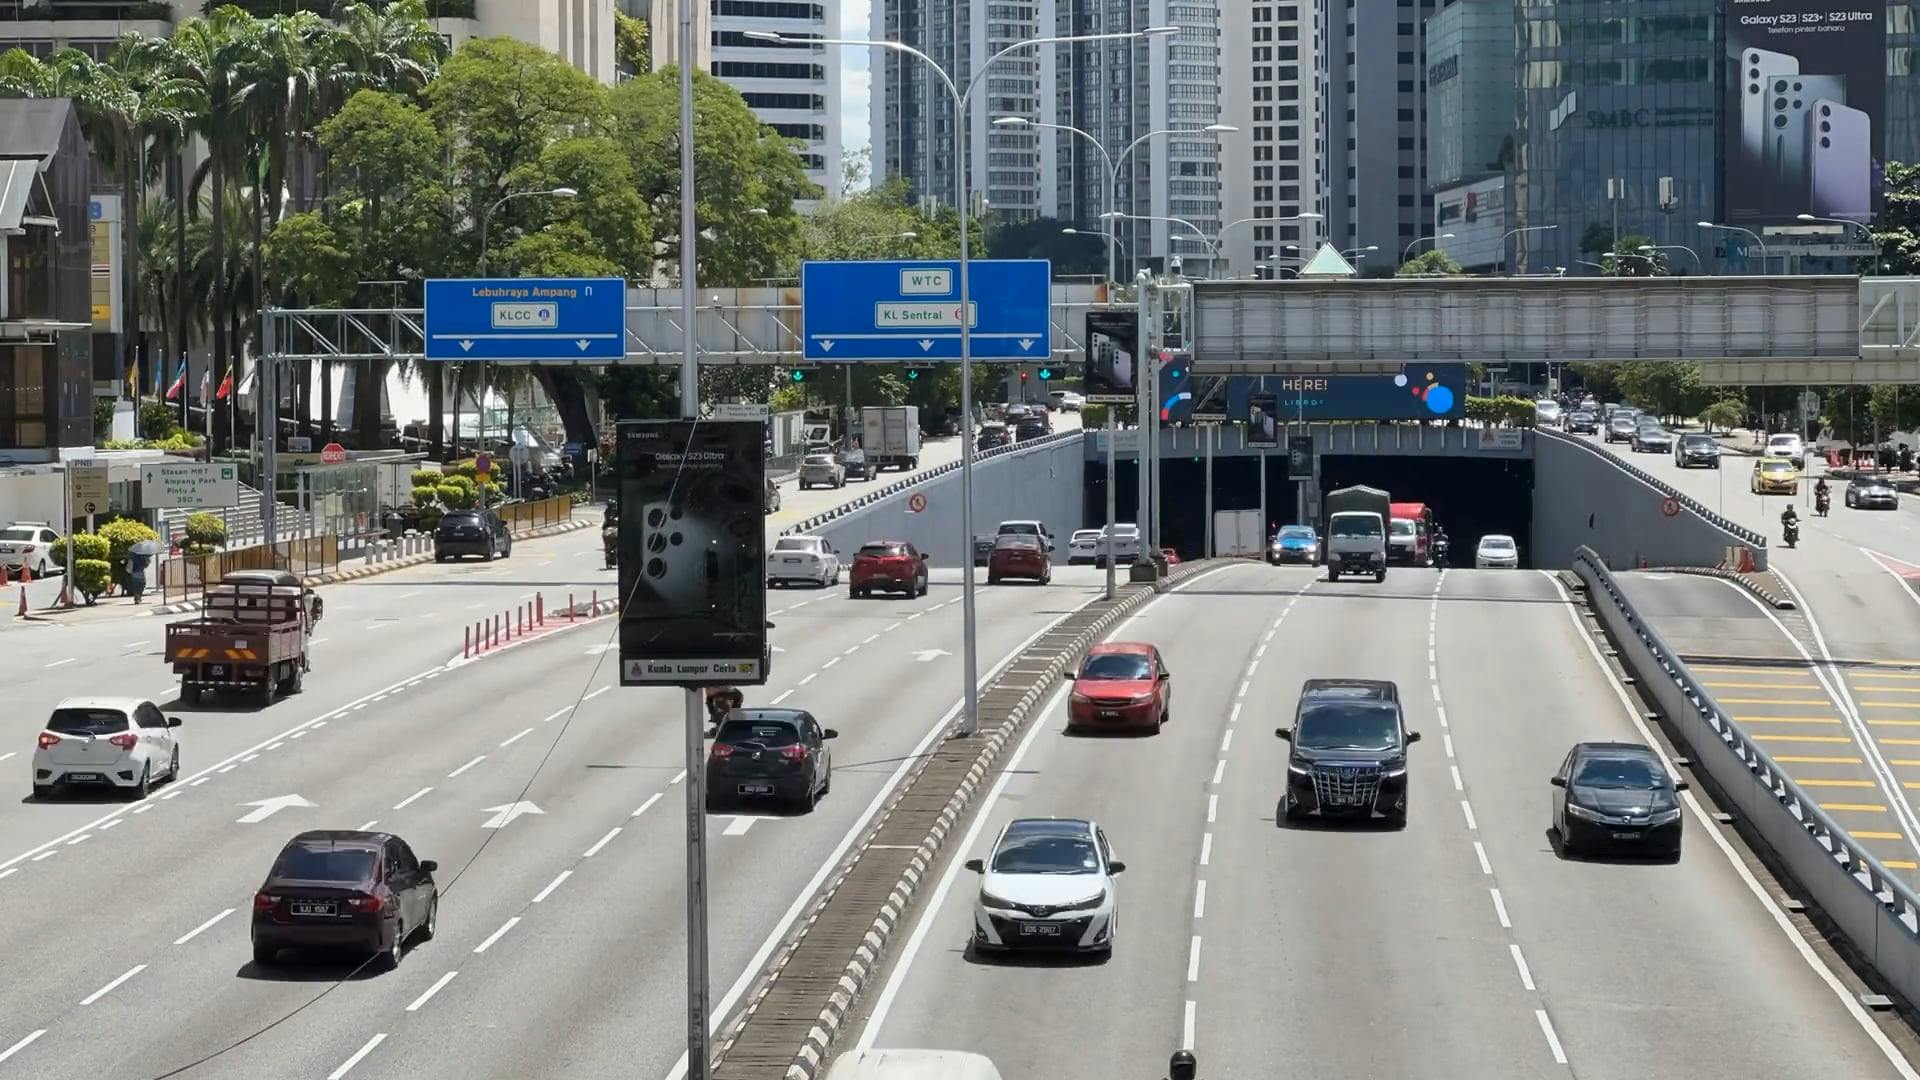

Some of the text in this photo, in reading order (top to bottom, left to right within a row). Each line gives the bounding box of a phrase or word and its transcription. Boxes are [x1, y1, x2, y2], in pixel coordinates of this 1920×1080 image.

[1740, 14, 1778, 25] Galaxy
[1779, 14, 1797, 23] S23
[1829, 12, 1846, 22] S23
[1847, 11, 1873, 21] Ultra
[1768, 26, 1794, 34] Telefon
[1586, 108, 1650, 129] SMBC
[911, 276, 942, 286] WTC
[472, 287, 577, 298] Lebuhraya Ampang
[499, 310, 532, 321] KLCC
[884, 310, 943, 320] KL Sentral
[1282, 379, 1328, 390] HERE!
[647, 663, 736, 674] Kuala Lumpur Ceria
